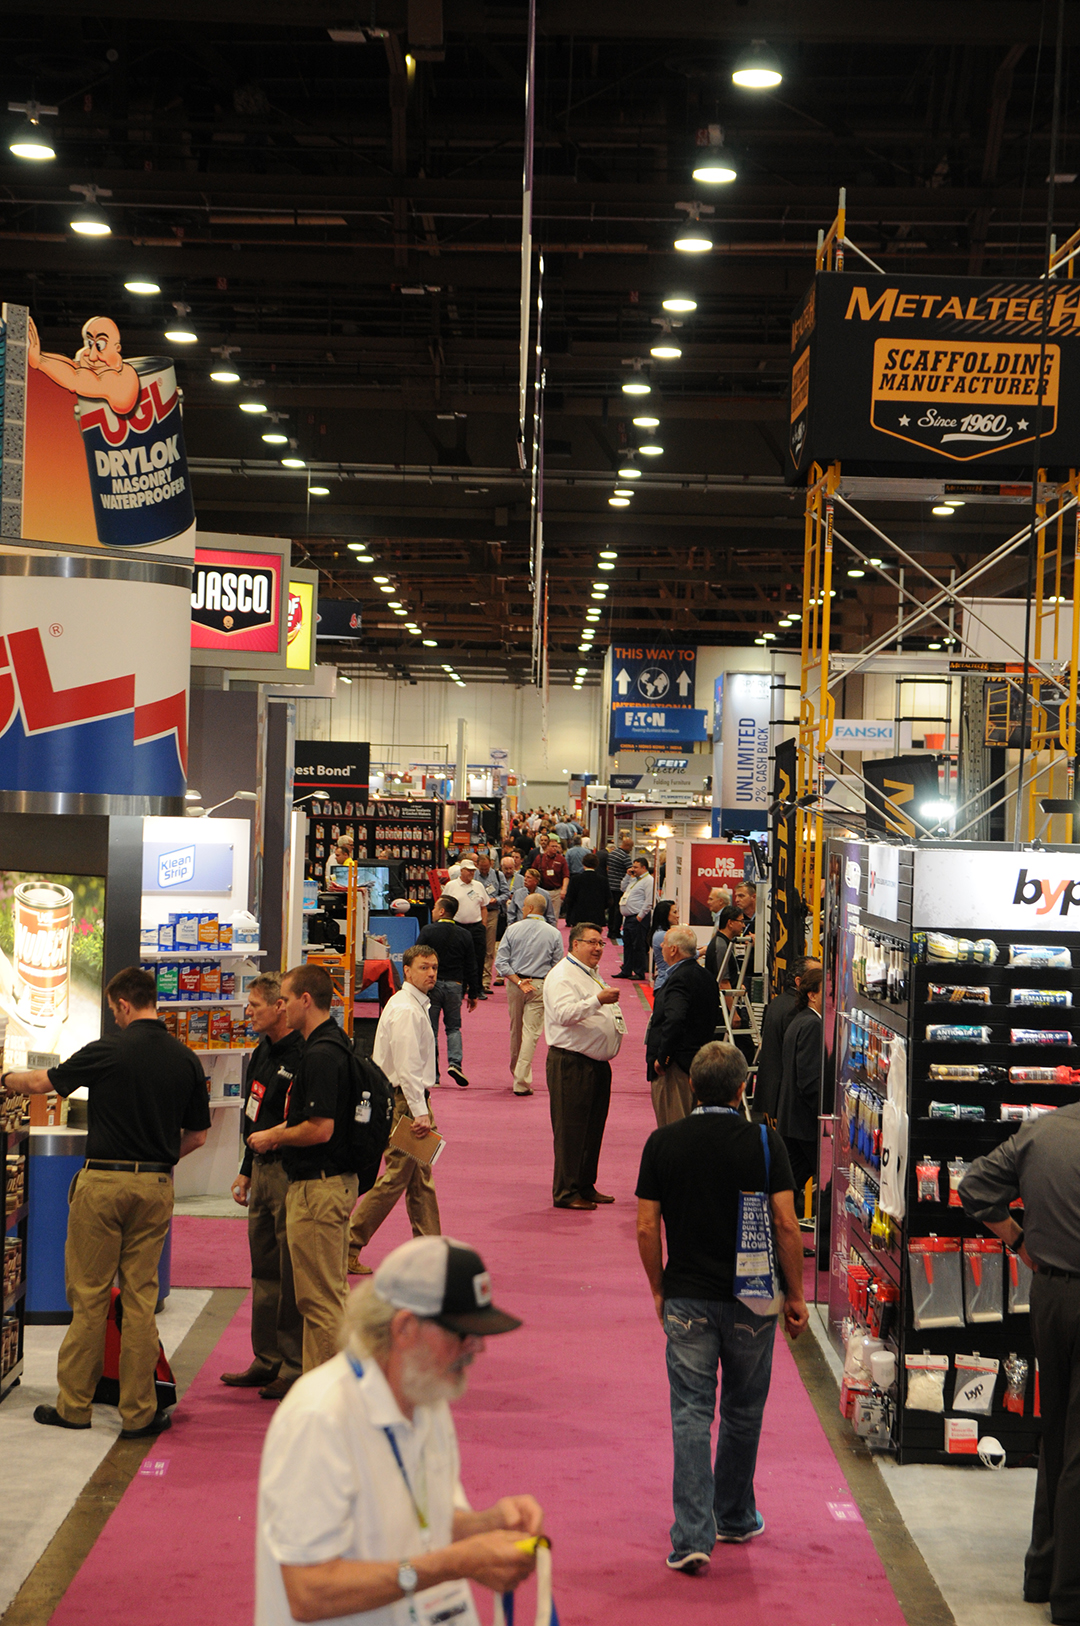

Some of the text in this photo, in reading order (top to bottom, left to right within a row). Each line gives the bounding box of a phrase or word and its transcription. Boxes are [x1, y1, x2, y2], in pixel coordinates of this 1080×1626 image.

[844, 285, 1080, 328] METALTECH
[884, 348, 1055, 375] SCAFFOLDING
[878, 373, 1048, 396] MANUFACTURER
[917, 408, 1010, 434] Since 1960
[95, 432, 181, 478] DRYLOK
[111, 466, 172, 495] MASONRY
[100, 476, 186, 510] WATERPROOFER
[614, 647, 695, 661] THIS WAY TO
[624, 711, 666, 727] EATON
[835, 726, 893, 738] FANSKI
[657, 759, 687, 767] FEIT
[736, 718, 756, 802] UNLIMITED
[755, 727, 769, 803] 2% CASH BACK
[294, 766, 314, 776] est
[161, 855, 191, 870] Klean
[715, 857, 735, 869] MS
[164, 867, 188, 880] Strip
[697, 868, 744, 877] POLYMER
[743, 1212, 754, 1220] 80
[964, 1383, 984, 1401] byp
